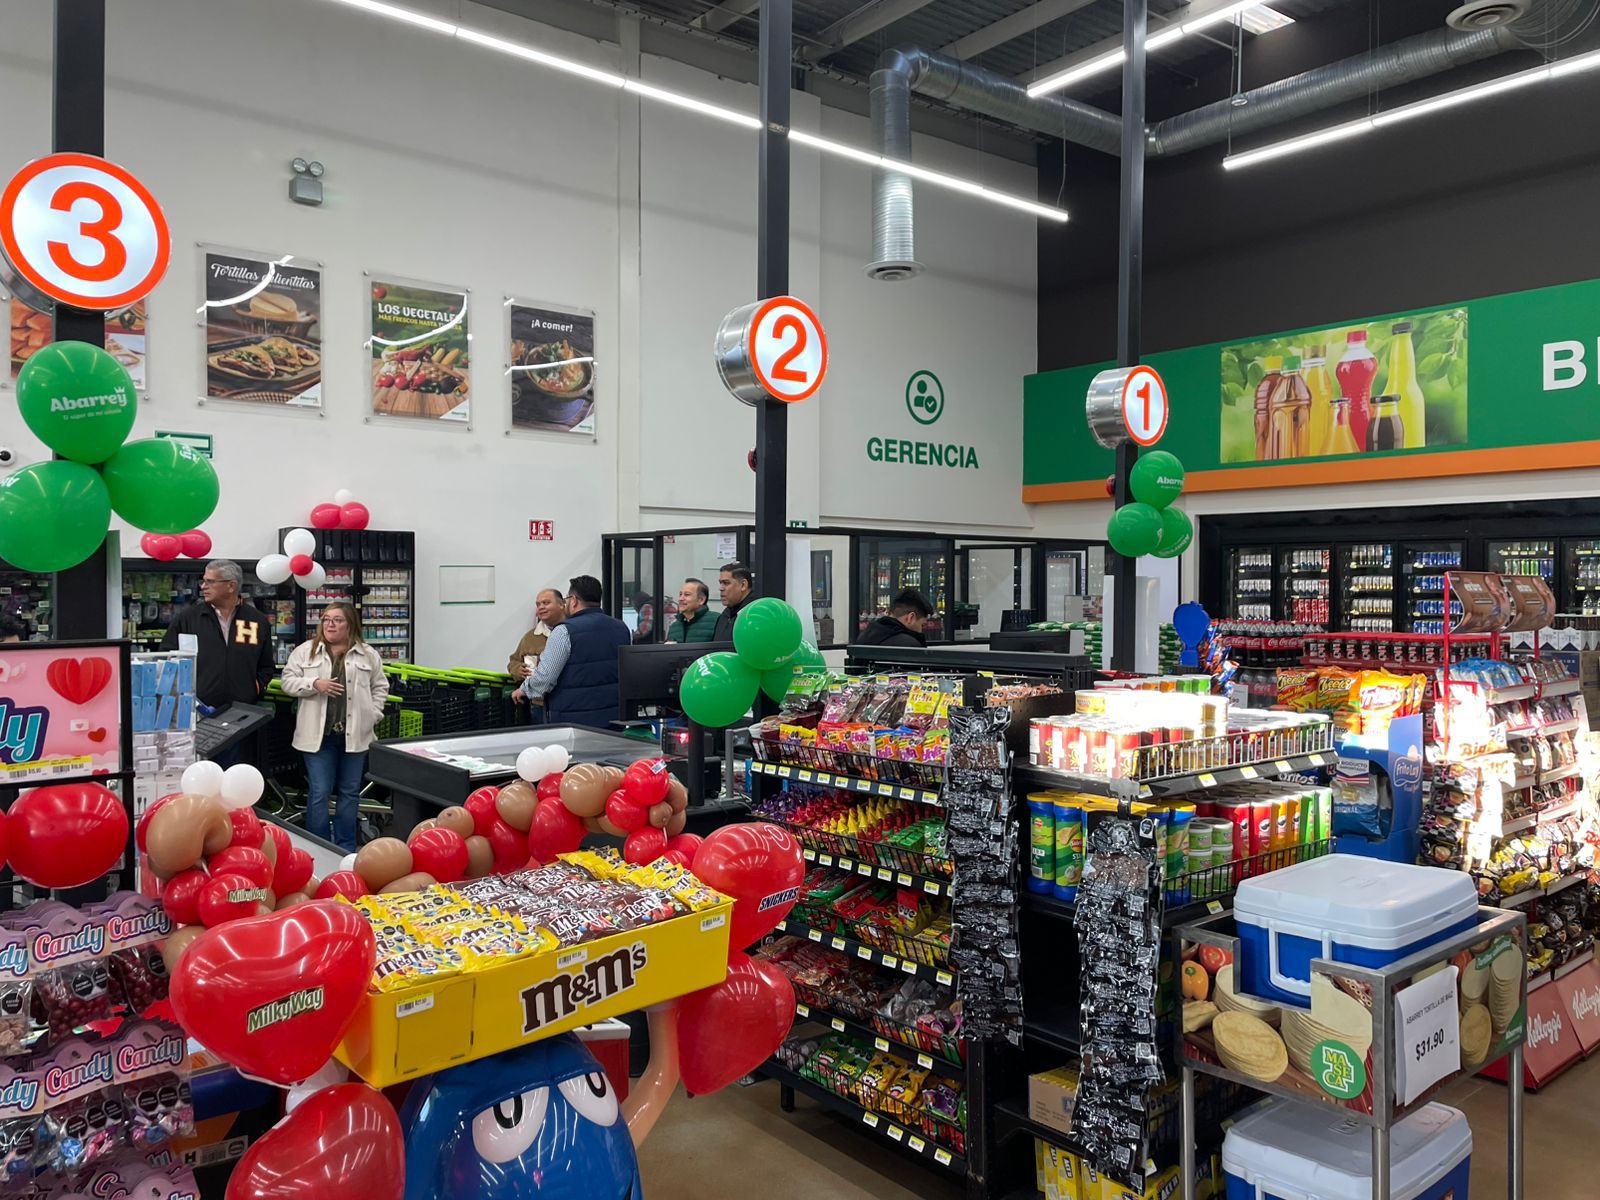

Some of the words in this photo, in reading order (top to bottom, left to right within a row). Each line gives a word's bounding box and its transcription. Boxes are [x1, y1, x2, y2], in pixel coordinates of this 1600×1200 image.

[47, 181, 127, 282] 3
[211, 263, 259, 281] Tortillas
[377, 302, 401, 315] LOS
[541, 320, 573, 333] comer!
[769, 314, 808, 383] 2
[1542, 336, 1600, 391] B
[50, 390, 128, 412] Abarrey
[1136, 381, 1151, 431] 1
[867, 436, 979, 470] GERENCIA
[234, 618, 259, 646] H
[1278, 771, 1317, 785] oritos
[759, 886, 800, 911] SNICKERS
[107, 905, 170, 941] Candy
[33, 923, 105, 962] Candy
[1415, 1028, 1444, 1062] $31.90
[1527, 1010, 1562, 1048] Kellogg's
[118, 1036, 183, 1073] Candy
[46, 1051, 113, 1096] Candy
